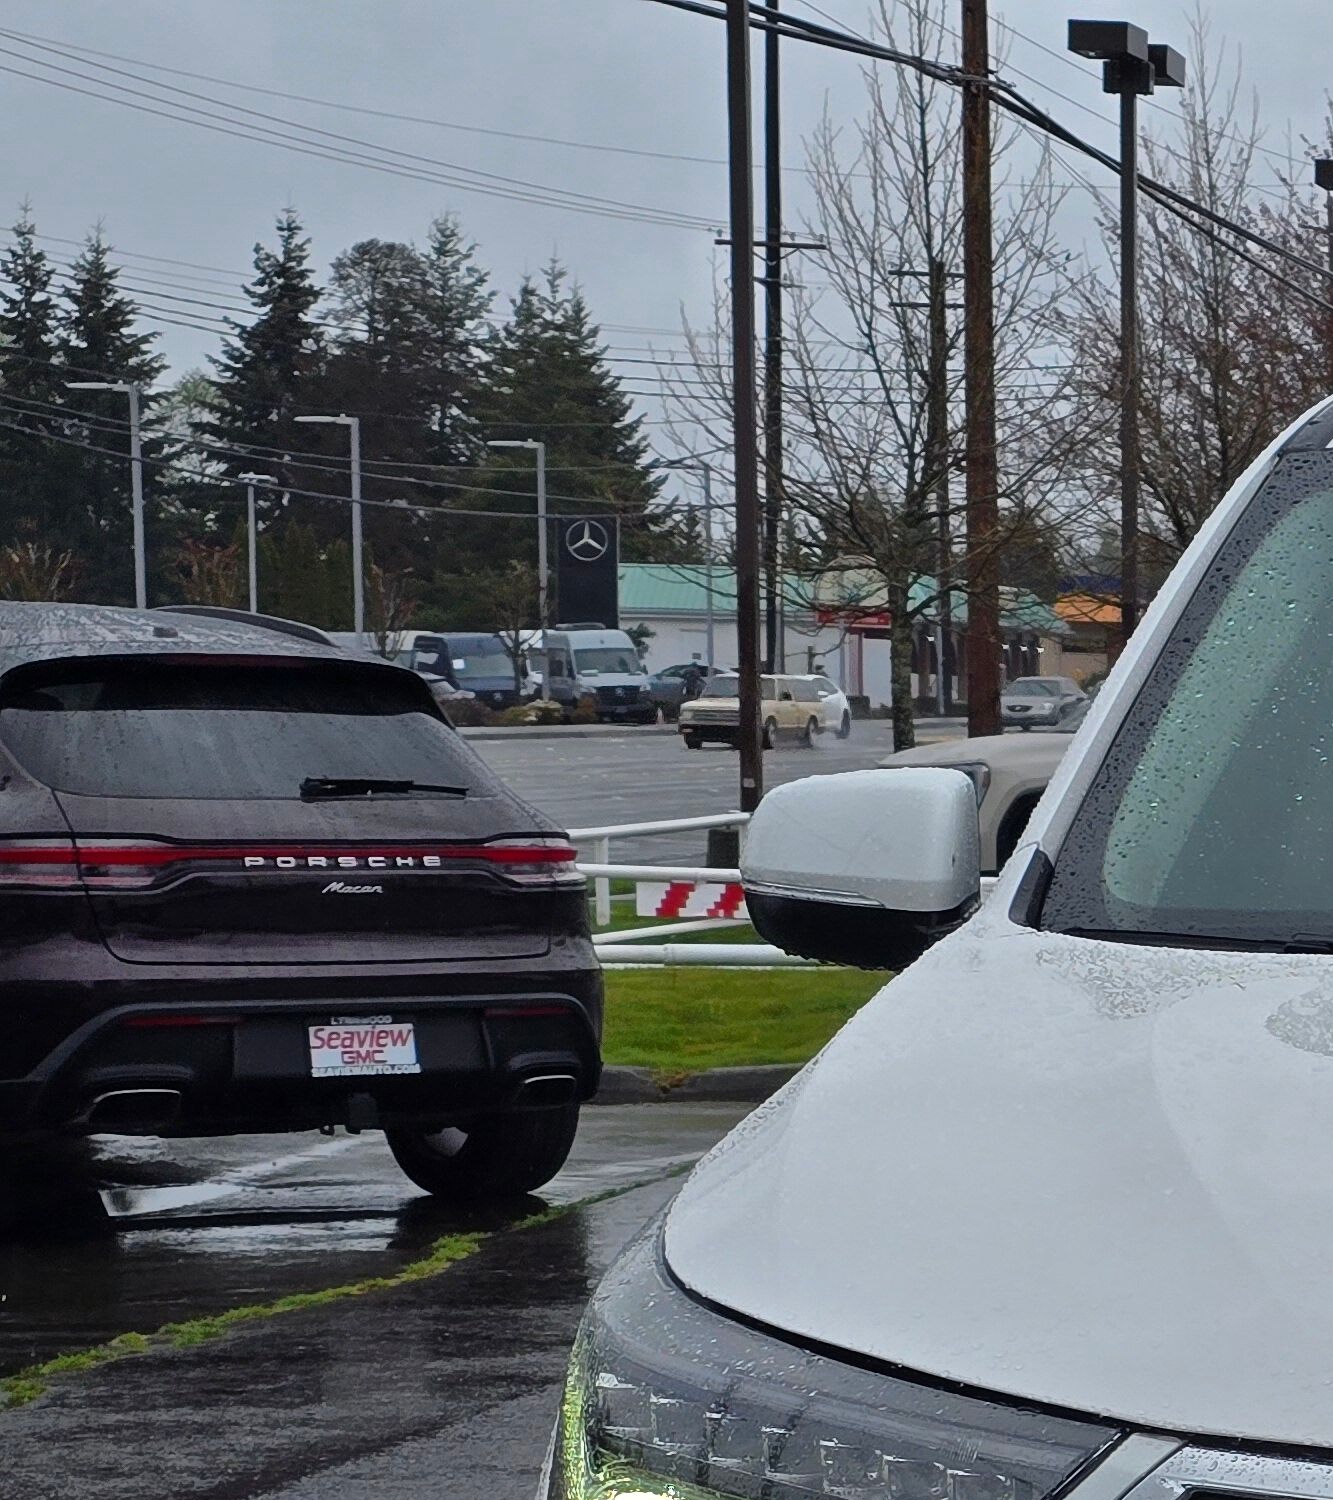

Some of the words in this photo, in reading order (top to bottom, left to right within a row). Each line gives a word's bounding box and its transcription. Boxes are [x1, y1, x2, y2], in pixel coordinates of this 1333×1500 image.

[244, 856, 441, 868] PORSCHE
[321, 881, 385, 894] Macan
[311, 1025, 412, 1049] Seaview
[341, 1050, 388, 1065] GMC
